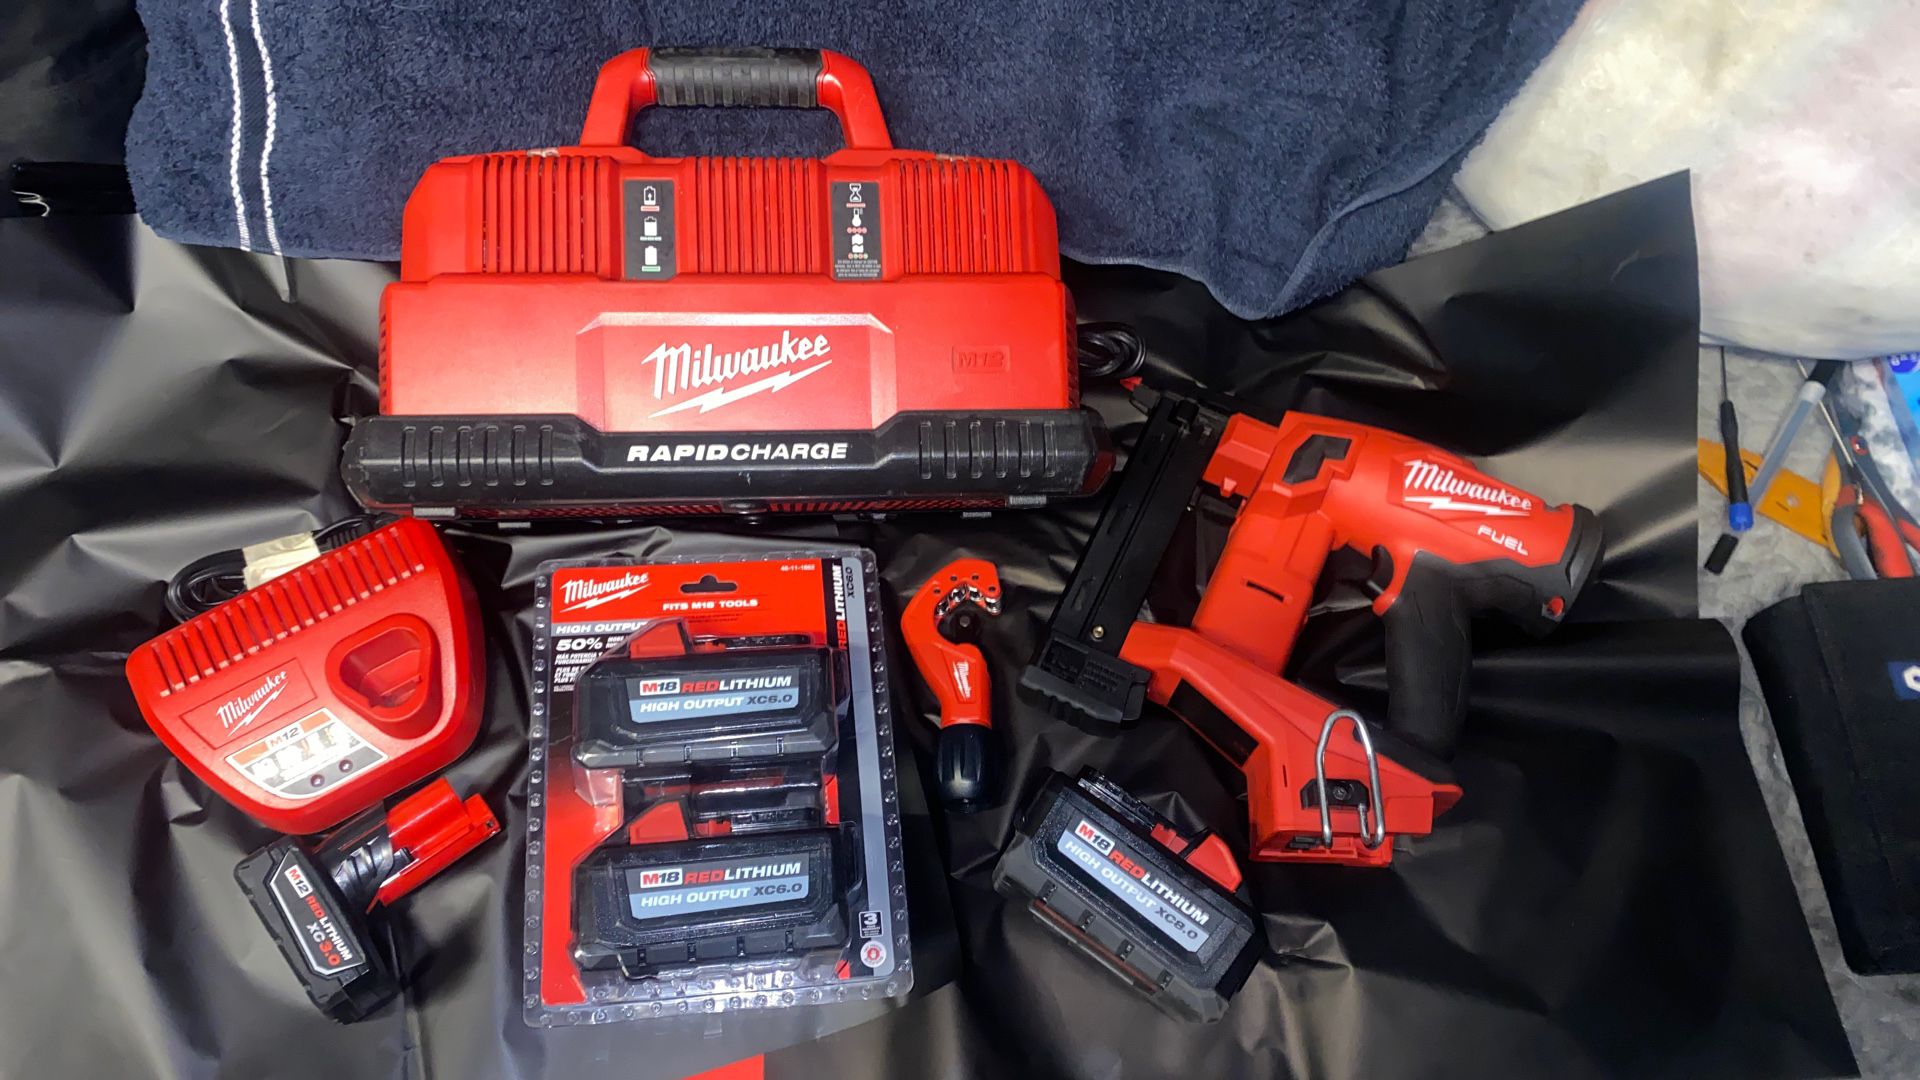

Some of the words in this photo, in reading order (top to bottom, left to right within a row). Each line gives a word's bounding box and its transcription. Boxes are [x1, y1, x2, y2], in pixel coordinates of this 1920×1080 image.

[641, 331, 831, 399] Milwaukee
[627, 443, 848, 462] RAPIDCHARGE
[1404, 459, 1532, 510] Milwaukee
[1477, 525, 1529, 556] FUEL
[560, 572, 649, 604] Milwaukee
[663, 603, 688, 611] FITS
[691, 601, 715, 610] M18
[719, 599, 758, 608] TOOLS
[832, 564, 847, 650] REDLITHIUM
[556, 625, 591, 634] HIGH
[556, 638, 603, 651] 50%
[642, 682, 677, 693] M18
[680, 675, 792, 694] REDLITHIUM
[216, 671, 288, 728] Milwaukee
[640, 700, 680, 713] HIGH
[684, 697, 745, 711] OUTPUT
[746, 693, 793, 706] XC6.0
[270, 727, 299, 747] M12
[642, 871, 680, 886] M18
[683, 862, 801, 885] REDLITHIUM
[1078, 823, 1111, 852] M18
[1108, 851, 1210, 925] REDLITHIUM
[640, 894, 683, 908] HIGH
[686, 887, 751, 903] OUTPUT
[753, 882, 803, 897] XC6.0
[1065, 841, 1101, 869] HIGH
[1101, 867, 1157, 908] OUTPUT
[1154, 906, 1198, 940] XC8.0
[288, 868, 311, 893] M12
[305, 895, 353, 961] REDLITHIUM
[864, 913, 878, 925] 3
[306, 922, 341, 967] XC3.0
